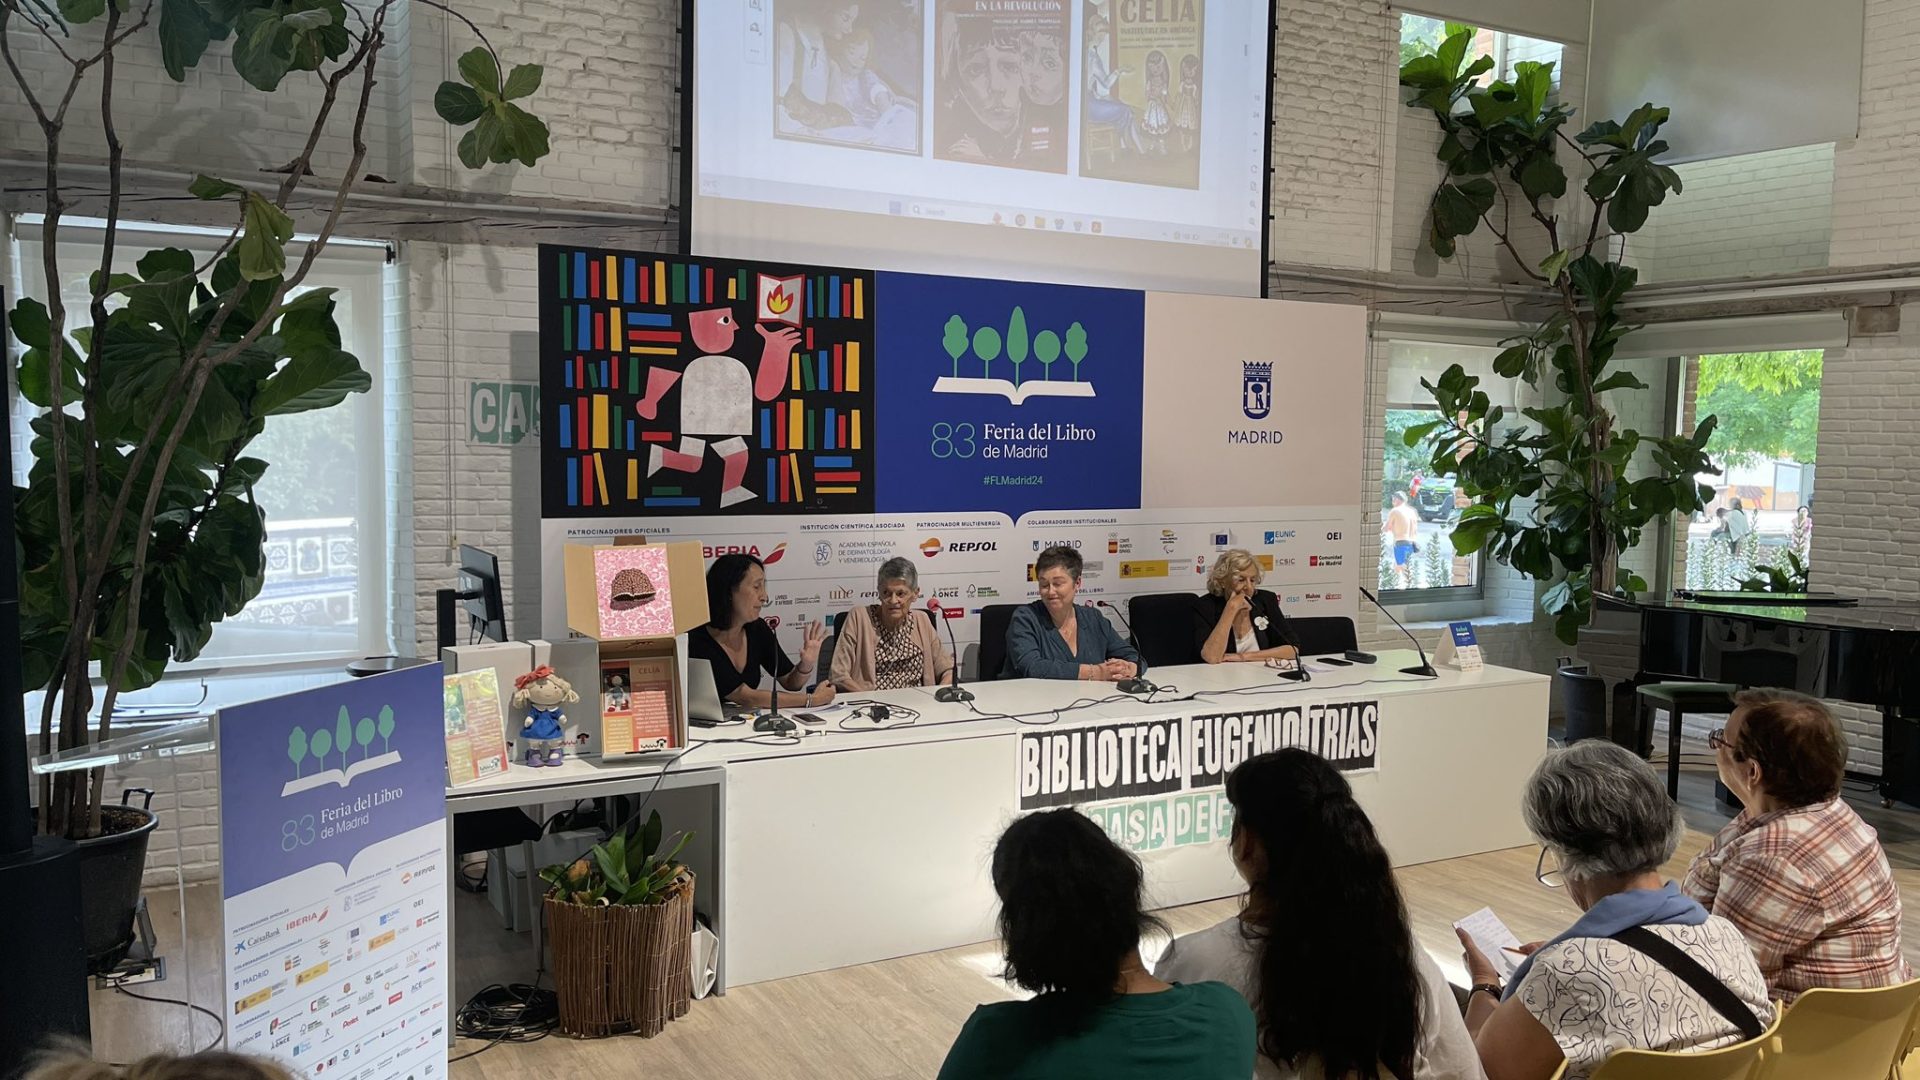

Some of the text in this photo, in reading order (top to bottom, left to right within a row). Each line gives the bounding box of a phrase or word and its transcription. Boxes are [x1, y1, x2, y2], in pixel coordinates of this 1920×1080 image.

[1120, 0, 1196, 23] CELIA
[473, 388, 540, 433] CA
[983, 423, 1096, 442] Feria del Libro
[1228, 431, 1283, 444] MADRID
[931, 422, 976, 459] 83
[983, 445, 1048, 459] de Madrid
[983, 475, 1043, 486] #FLMadrid24
[1275, 530, 1296, 538] EUNIC
[1327, 532, 1342, 540] OEI
[703, 545, 760, 558] BERIA
[949, 541, 997, 552] REPSOL
[1044, 540, 1082, 549] MADRID
[638, 666, 660, 674] CELIA
[1021, 705, 1377, 797] BIBLIOTECA EUGENIO TRIAS
[321, 786, 403, 824] Feria del Libro
[1092, 806, 1165, 843] ASA
[1176, 799, 1209, 836] DE
[281, 813, 370, 851] 83 de Madrid
[413, 864, 435, 878] REPSOL
[247, 912, 318, 947] CaixaBank IBERIA
[242, 969, 269, 986] MADRID
